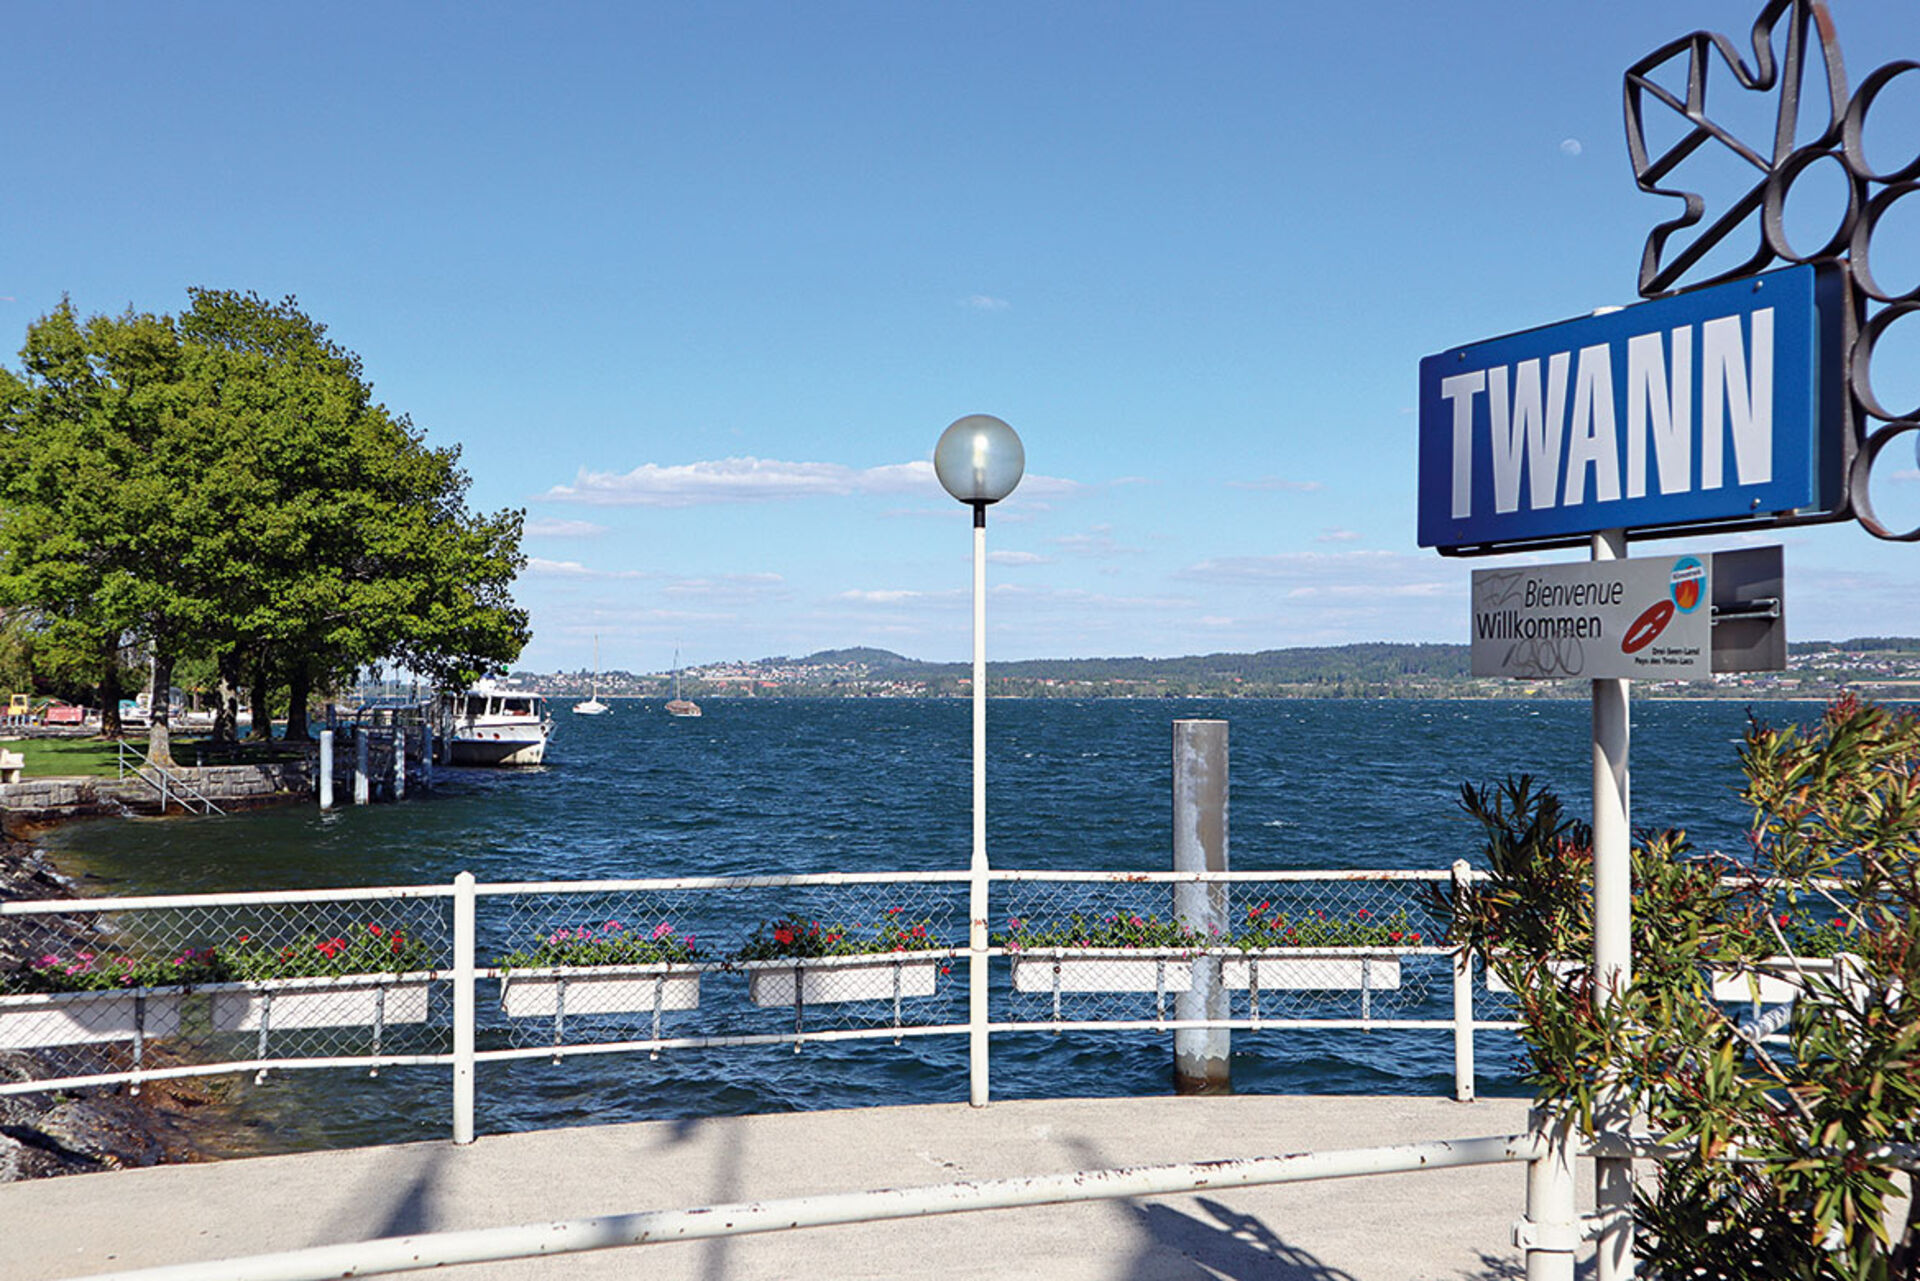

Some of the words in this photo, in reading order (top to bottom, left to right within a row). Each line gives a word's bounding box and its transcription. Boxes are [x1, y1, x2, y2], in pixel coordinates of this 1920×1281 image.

[1441, 306, 1775, 519] TWANN
[1525, 578, 1624, 608] Bienvenue
[1476, 610, 1602, 640] Willkommen
